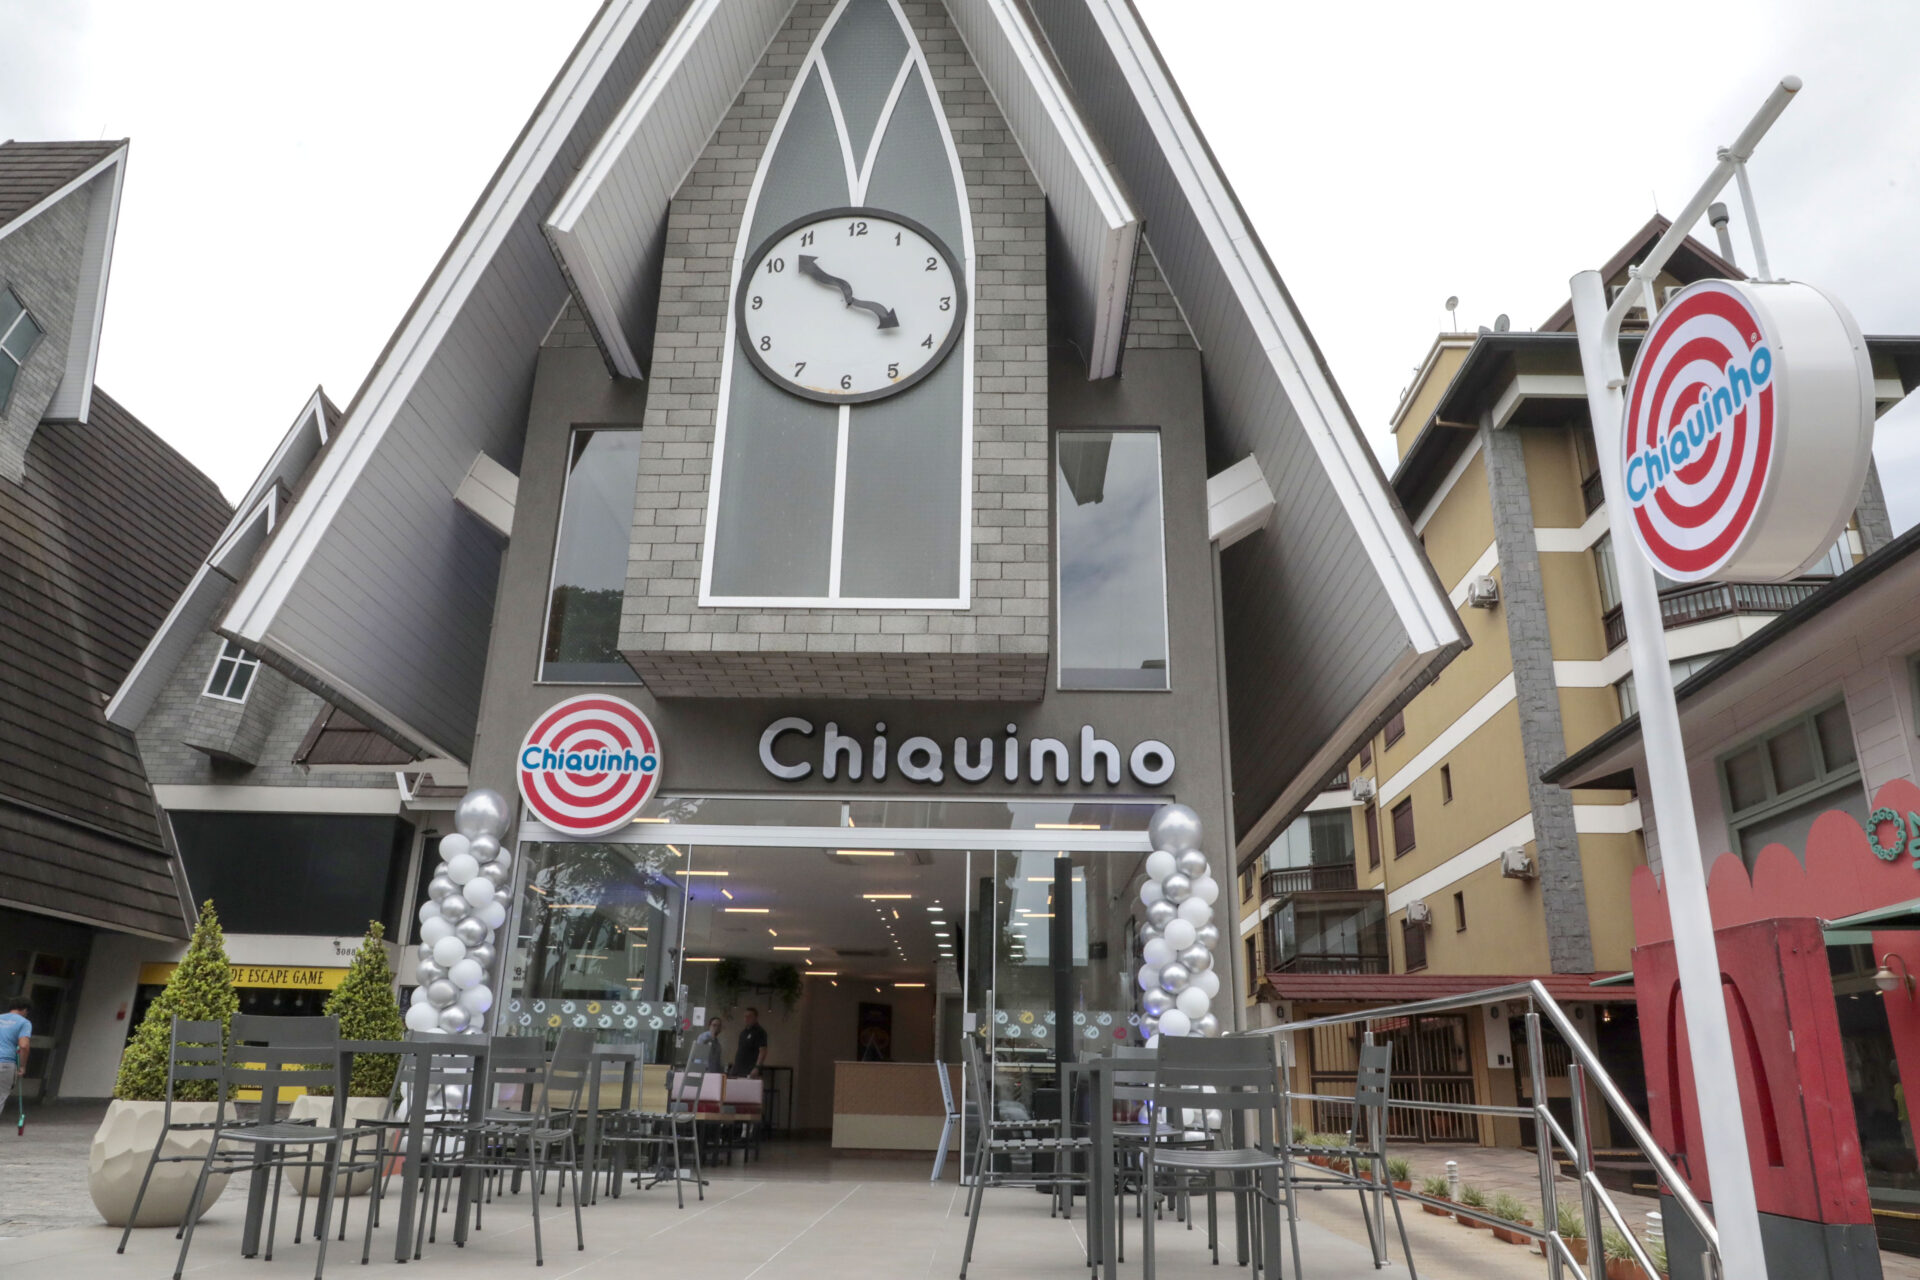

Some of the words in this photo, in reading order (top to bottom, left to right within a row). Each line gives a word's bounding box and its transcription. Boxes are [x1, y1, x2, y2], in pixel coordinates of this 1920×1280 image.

[848, 221, 868, 237] 12
[800, 230, 814, 248] 11
[766, 257, 785, 274] 10
[925, 257, 938, 272] 2
[751, 295, 763, 310] 9
[939, 296, 951, 311] 3
[759, 335, 772, 352] 8
[921, 333, 934, 350] 4
[794, 362, 807, 378] 7
[887, 362, 900, 379] 5
[840, 374, 852, 390] 6
[1626, 346, 1772, 502] Chiquinho
[521, 746, 657, 772] Chiquinho
[758, 716, 1176, 786] Chiquinho
[248, 969, 288, 985] ESCAPE
[293, 970, 324, 986] GAME
